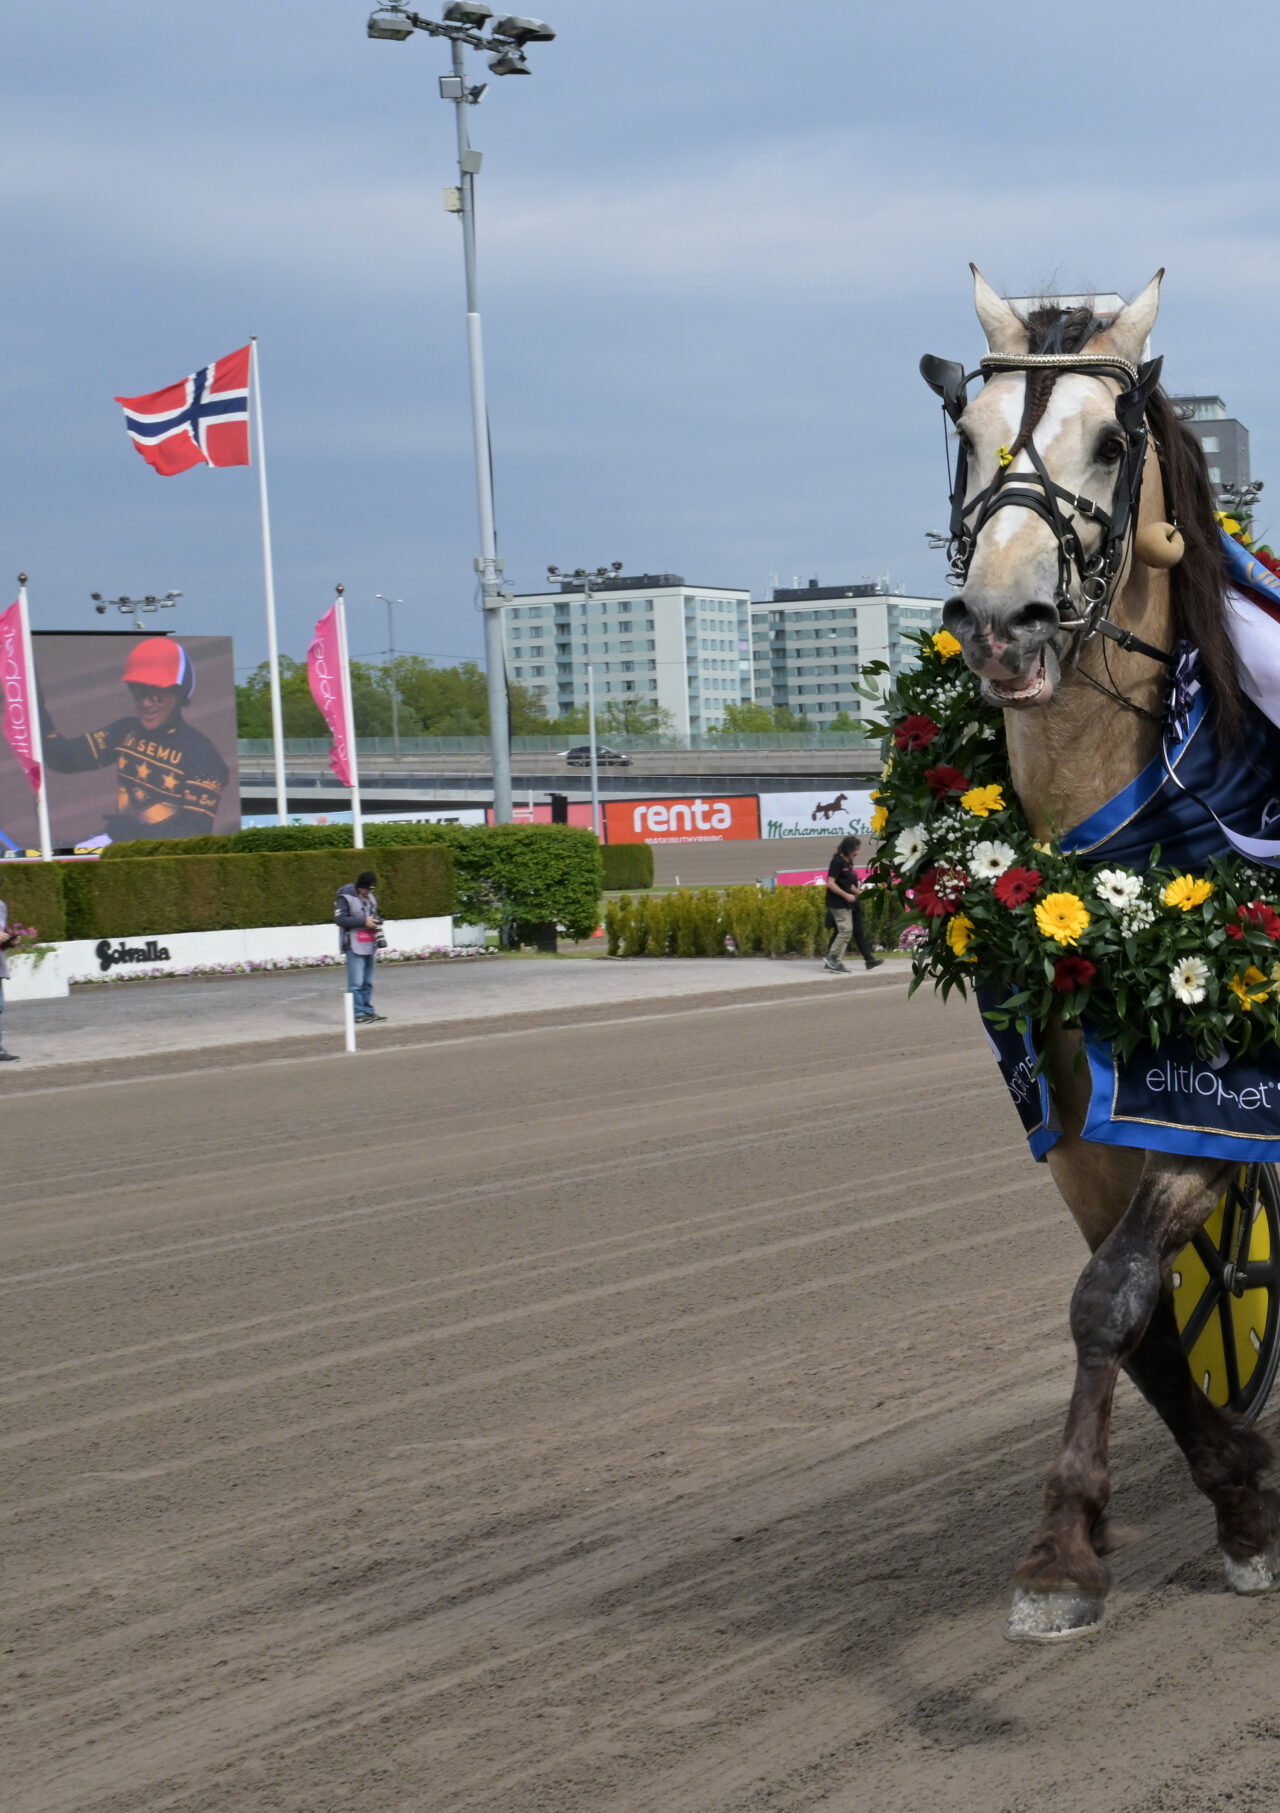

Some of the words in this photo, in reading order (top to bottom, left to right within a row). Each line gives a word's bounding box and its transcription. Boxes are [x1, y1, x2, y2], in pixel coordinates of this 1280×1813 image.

[137, 739, 183, 764] SEMU
[633, 798, 732, 833] renta
[767, 820, 844, 838] Menhammar
[96, 940, 171, 972] Solvalla
